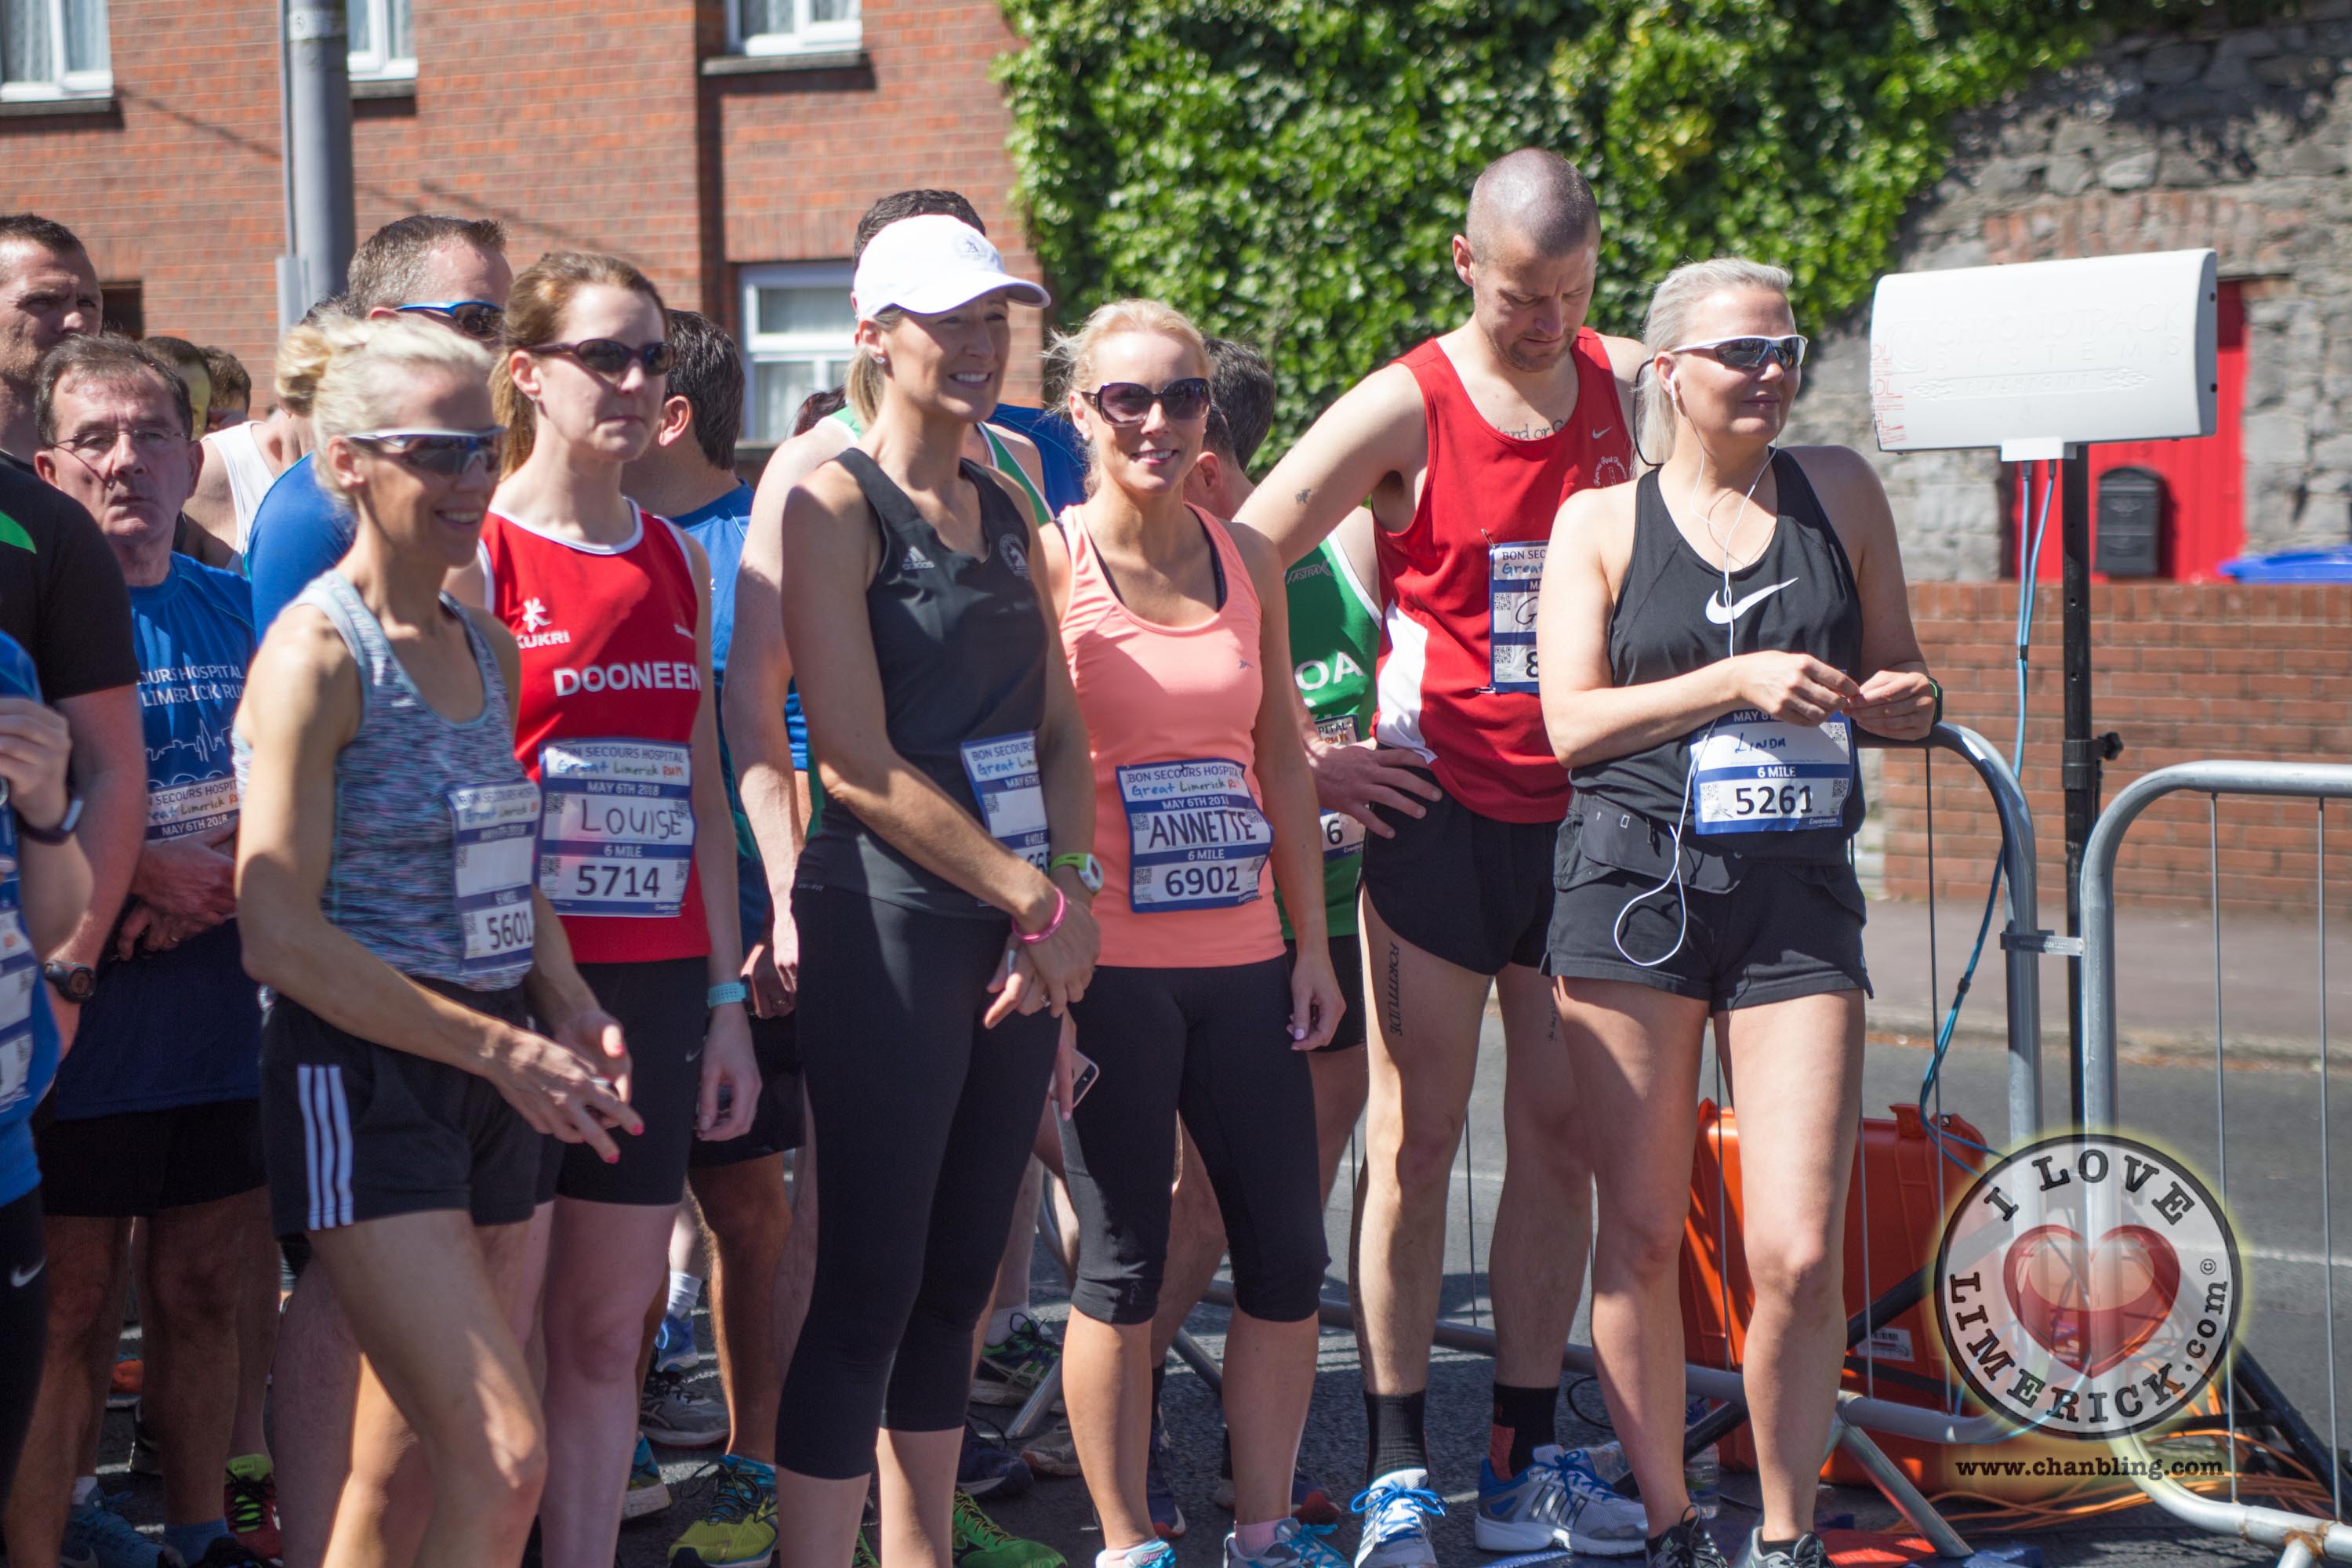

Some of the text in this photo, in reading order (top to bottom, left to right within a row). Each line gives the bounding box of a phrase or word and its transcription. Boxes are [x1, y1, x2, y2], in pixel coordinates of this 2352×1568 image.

[1534, 427, 1549, 439] or
[1502, 551, 1524, 560] BON
[179, 665, 245, 681] HOSPITAL
[141, 684, 221, 707] LIMERICK
[1733, 710, 1759, 722] MAY
[586, 746, 639, 759] SECOURS
[642, 748, 684, 763] HOSPITAL
[971, 748, 993, 762] BON
[613, 760, 659, 775] Limerick
[977, 759, 1014, 777] Great
[1127, 771, 1151, 783] BON
[1154, 766, 1201, 781] SECOURS
[1757, 767, 1796, 779] 6 MILE
[589, 781, 612, 793] MAY
[615, 782, 636, 795] 6TH
[1131, 785, 1174, 798] Great
[1179, 778, 1226, 793] Limerick
[156, 788, 202, 806] SECOURS
[1161, 799, 1185, 810] MAY
[1187, 797, 1207, 808] 6TH
[1736, 786, 1813, 815] 5261
[180, 797, 225, 815] Limerick
[187, 819, 205, 831] 6TH
[581, 799, 682, 840] LOUISE
[1149, 810, 1257, 849] ANNETTE
[604, 844, 643, 858] 6 MILE
[1188, 848, 1225, 860] 6 MILE
[576, 865, 660, 898] 5714
[1165, 866, 1240, 897] 6902
[487, 911, 532, 950] 5601
